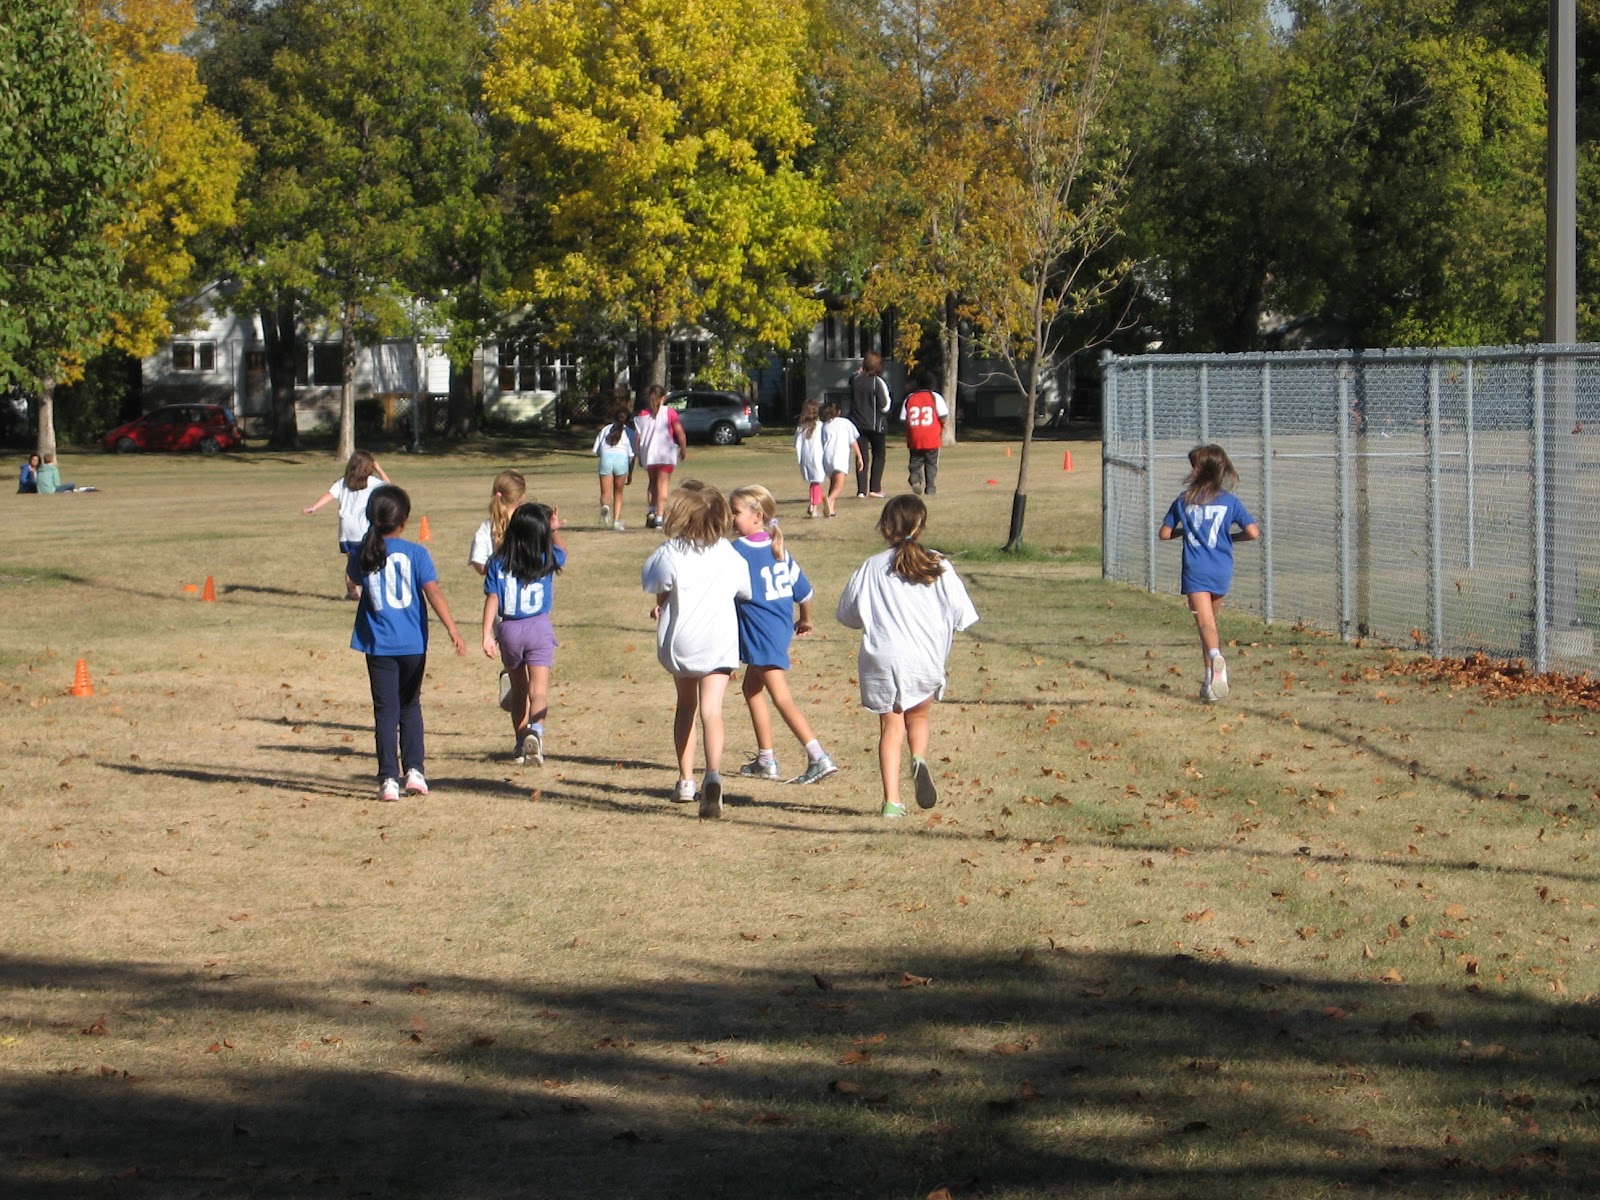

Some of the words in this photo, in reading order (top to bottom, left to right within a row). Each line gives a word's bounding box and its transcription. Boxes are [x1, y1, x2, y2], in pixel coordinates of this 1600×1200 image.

[909, 405, 933, 426] 23
[368, 552, 413, 611] 10
[760, 561, 794, 601] 12
